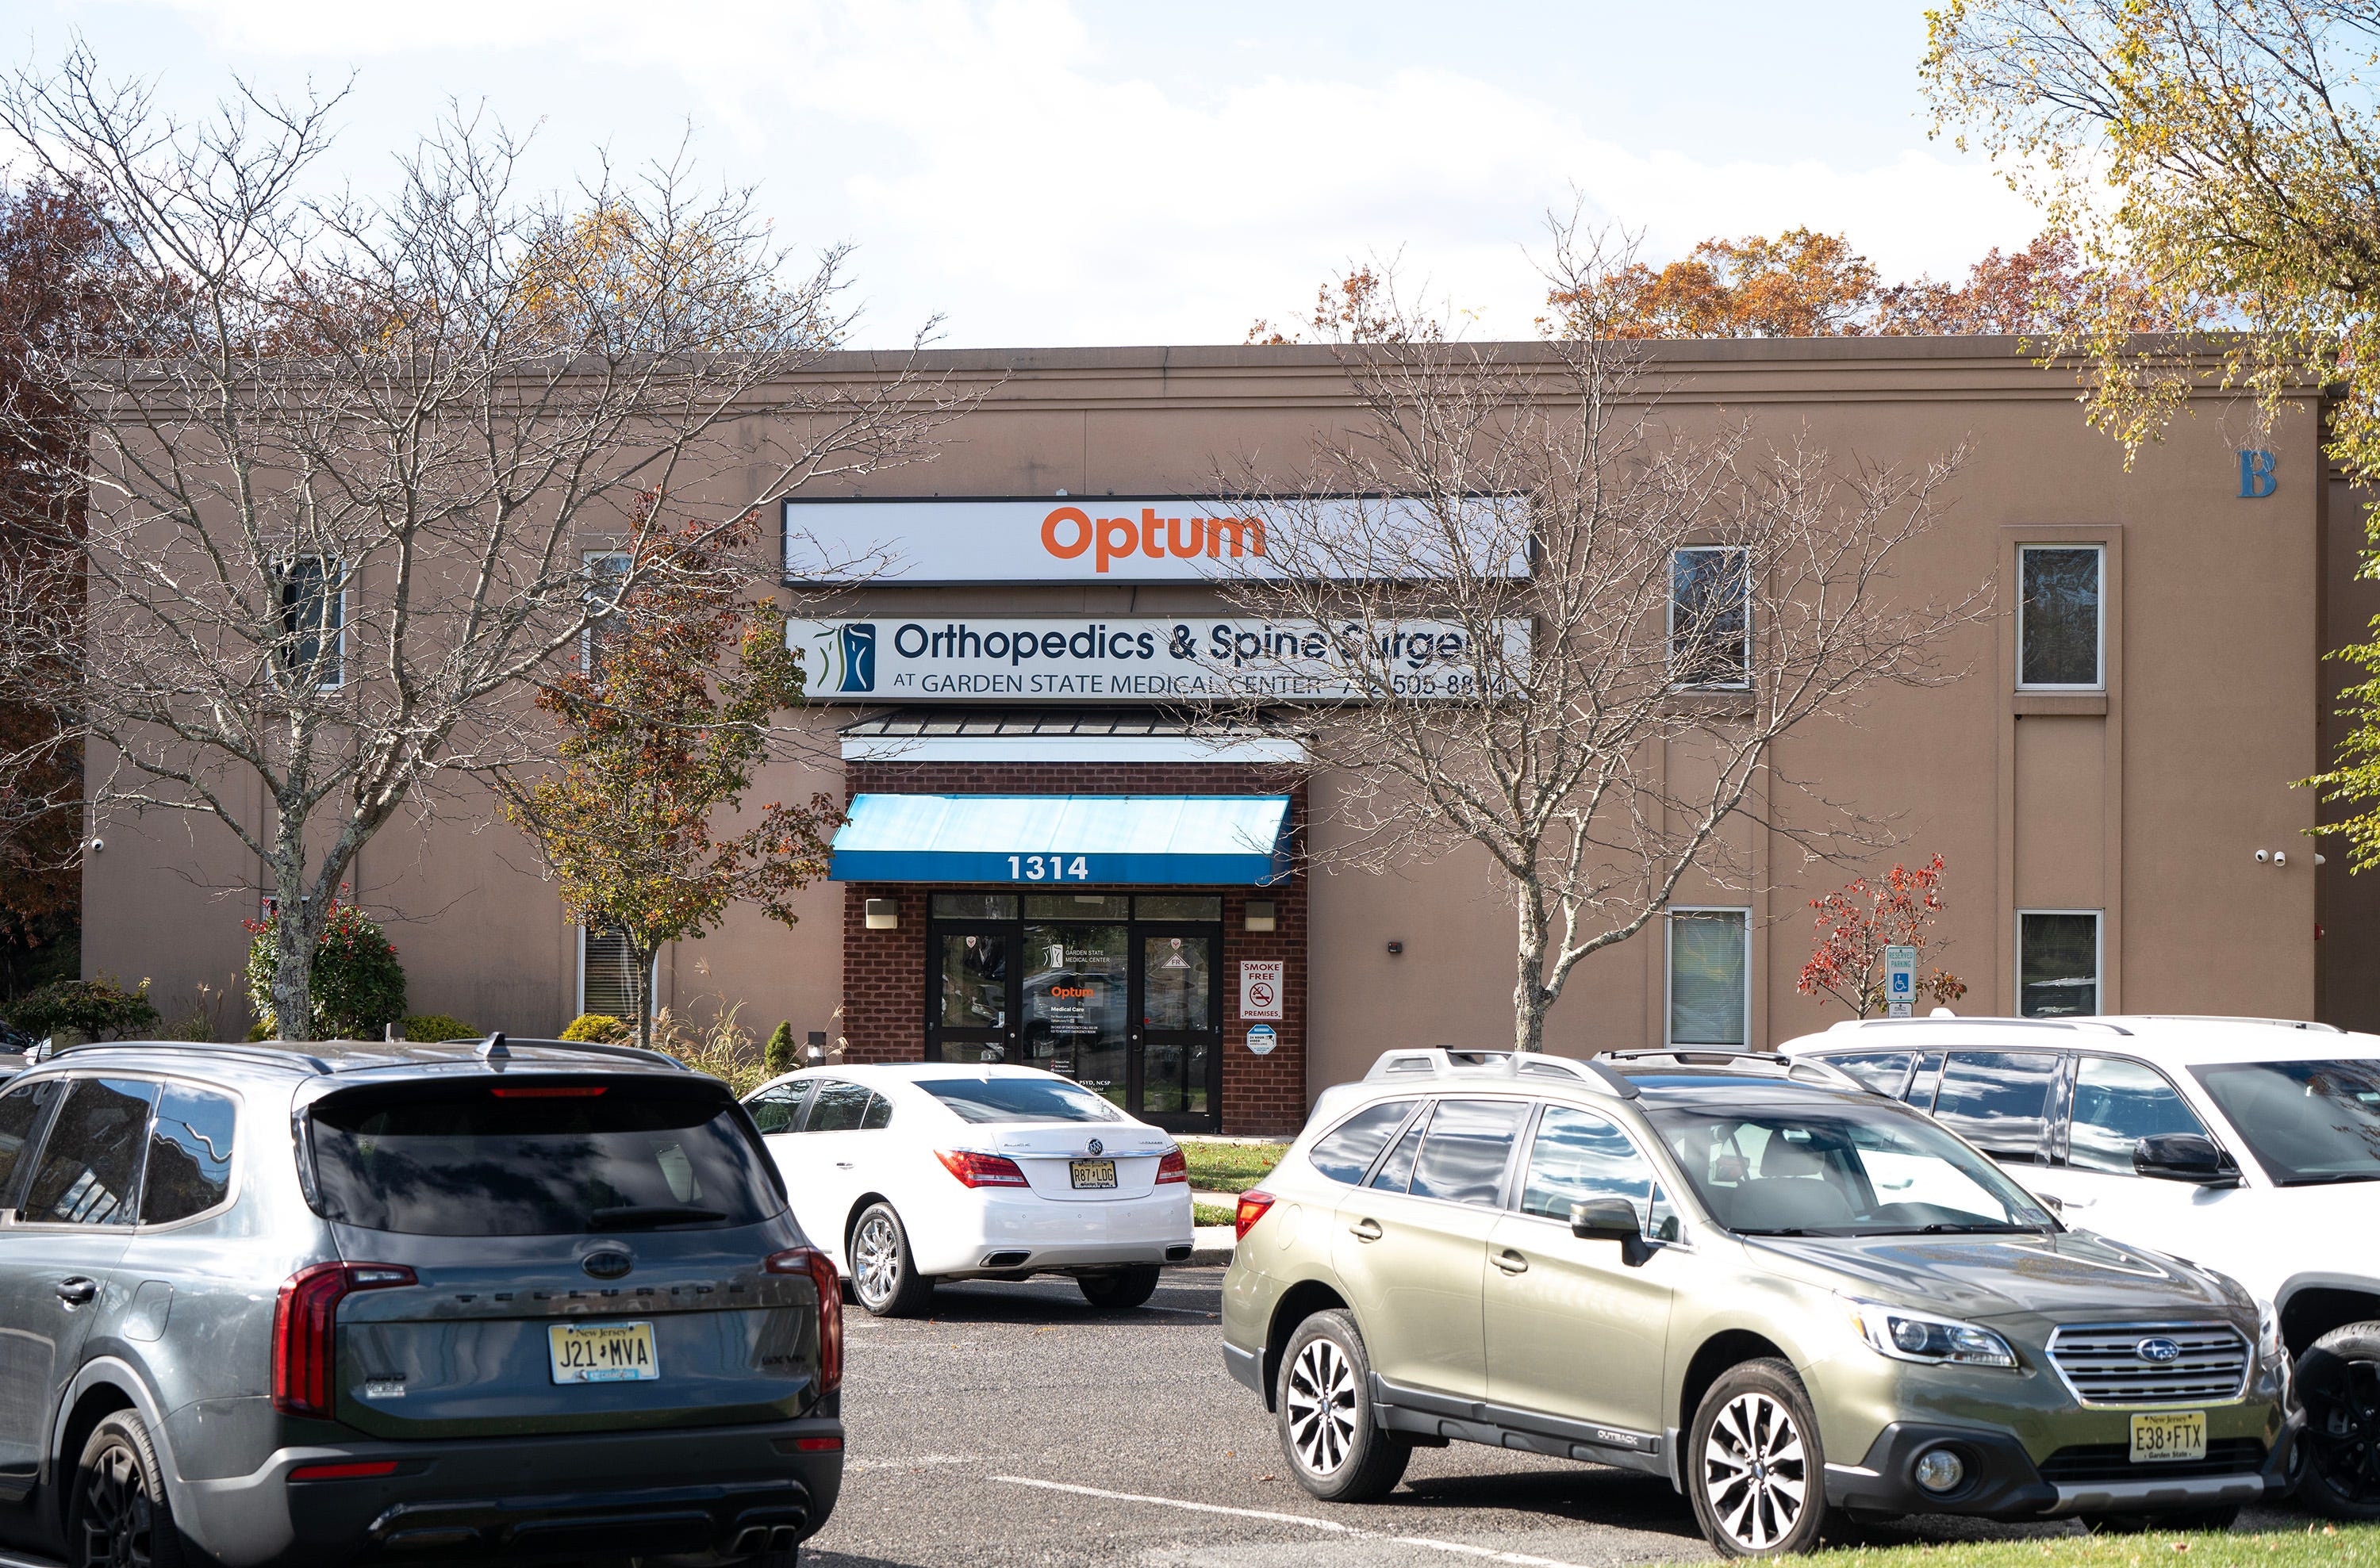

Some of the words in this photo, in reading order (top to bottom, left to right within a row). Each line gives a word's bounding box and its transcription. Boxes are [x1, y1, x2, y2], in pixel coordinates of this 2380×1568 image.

[2234, 450, 2276, 497] B
[1041, 507, 1266, 573] Optum
[894, 623, 1154, 666] Orthopedics
[1169, 624, 1196, 660] &
[1210, 624, 1326, 667] Spine
[1340, 624, 1501, 669] Surge
[893, 673, 916, 686] AT
[921, 674, 1023, 692] GARDEN
[1031, 674, 1104, 693] STATE
[1111, 675, 1218, 694] MEDICAL
[1007, 856, 1088, 880] 1314
[1051, 986, 1094, 1000] Optum
[1074, 1168, 1091, 1182] R87
[1096, 1168, 1113, 1181] LDG
[576, 1328, 597, 1337] New
[598, 1327, 628, 1338] Jersey
[560, 1340, 597, 1367] J21
[609, 1338, 648, 1366] MVA
[2149, 1415, 2165, 1424] New
[2166, 1414, 2187, 1424] Jersey
[1597, 1429, 1638, 1445] OUTBACK
[2136, 1426, 2164, 1451] E38
[2173, 1424, 2201, 1449] FTX
